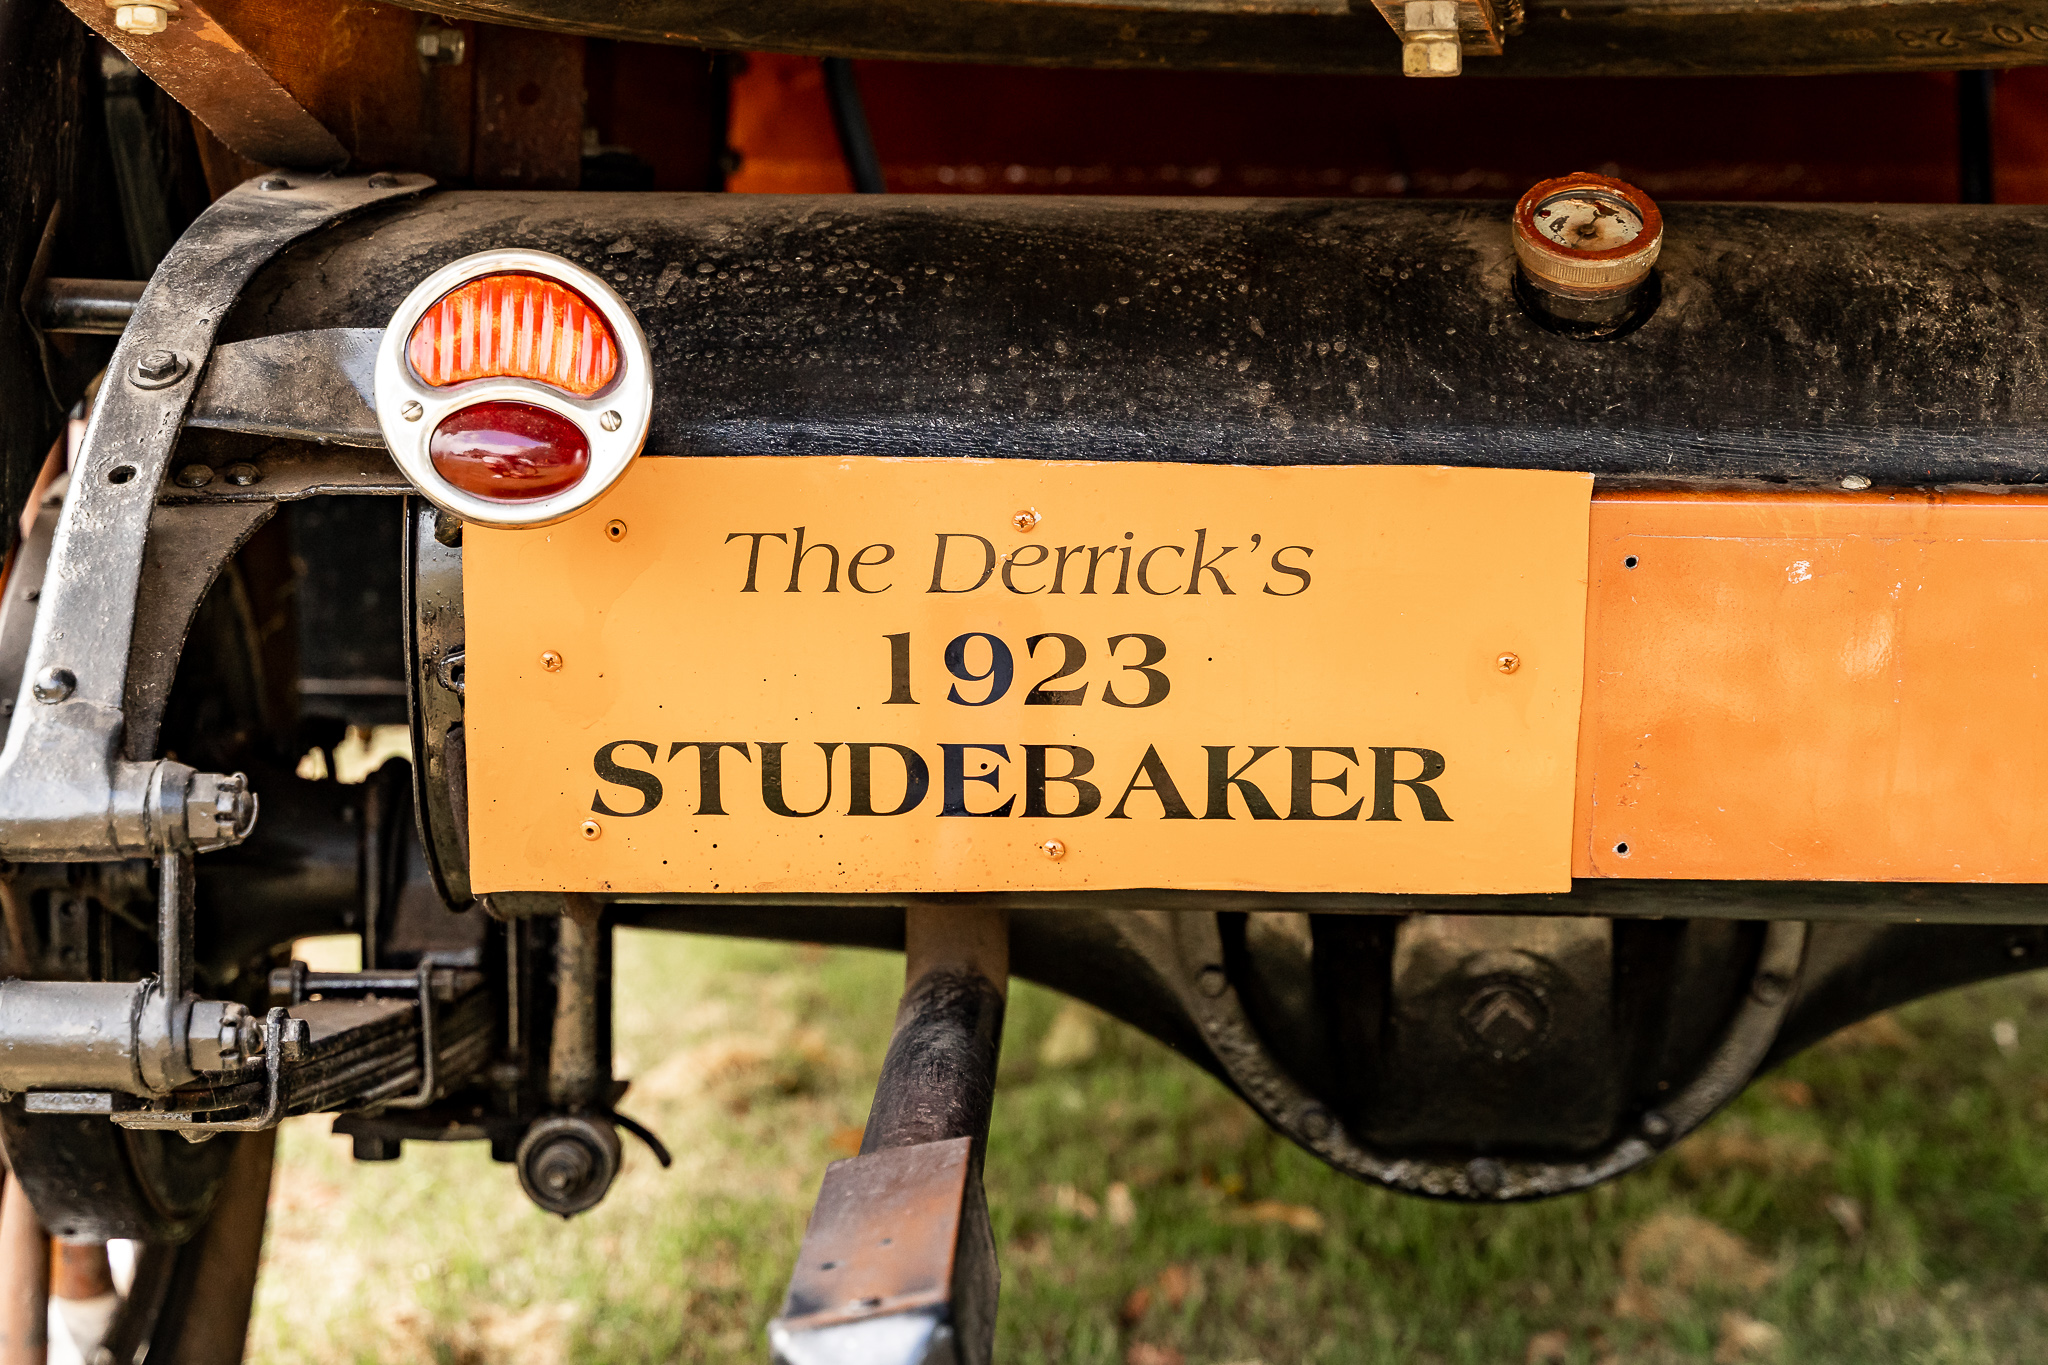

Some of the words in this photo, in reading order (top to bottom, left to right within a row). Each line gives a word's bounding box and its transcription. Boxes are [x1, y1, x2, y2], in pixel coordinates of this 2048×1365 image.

[724, 526, 896, 595] The
[925, 526, 1315, 598] Derrick's
[881, 631, 1171, 709] 1923
[590, 739, 1455, 822] STUDEBAKER
